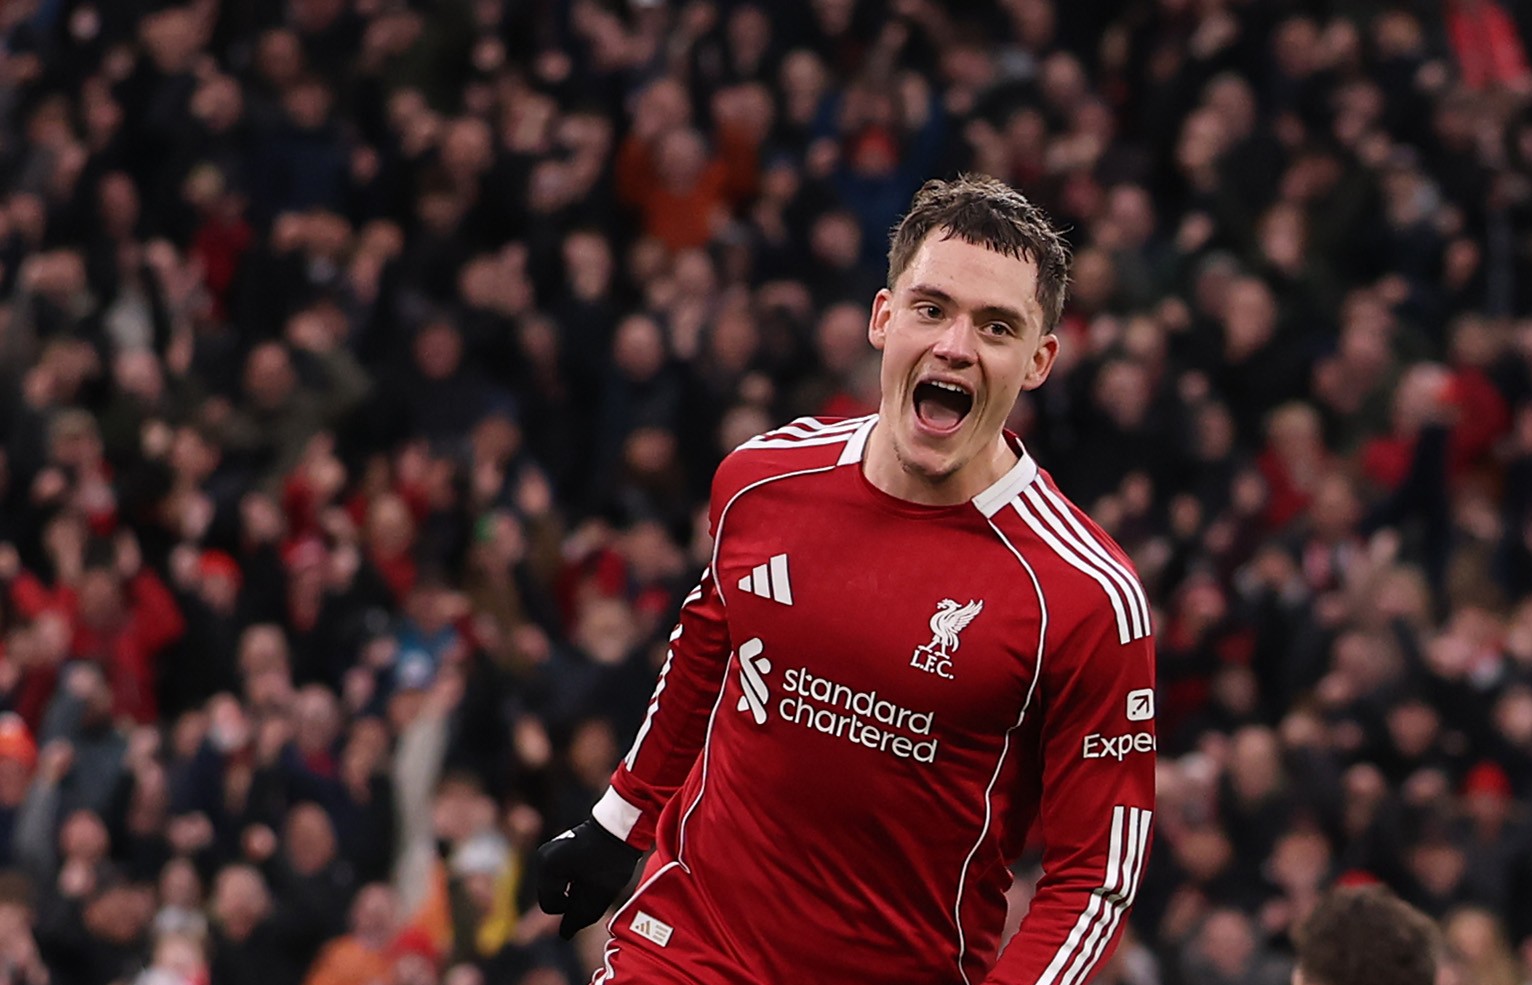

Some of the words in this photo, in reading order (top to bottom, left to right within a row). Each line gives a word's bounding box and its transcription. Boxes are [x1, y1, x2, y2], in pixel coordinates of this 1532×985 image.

[910, 649, 954, 679] L.F.C.
[779, 696, 938, 763] chartered
[782, 667, 935, 735] standard
